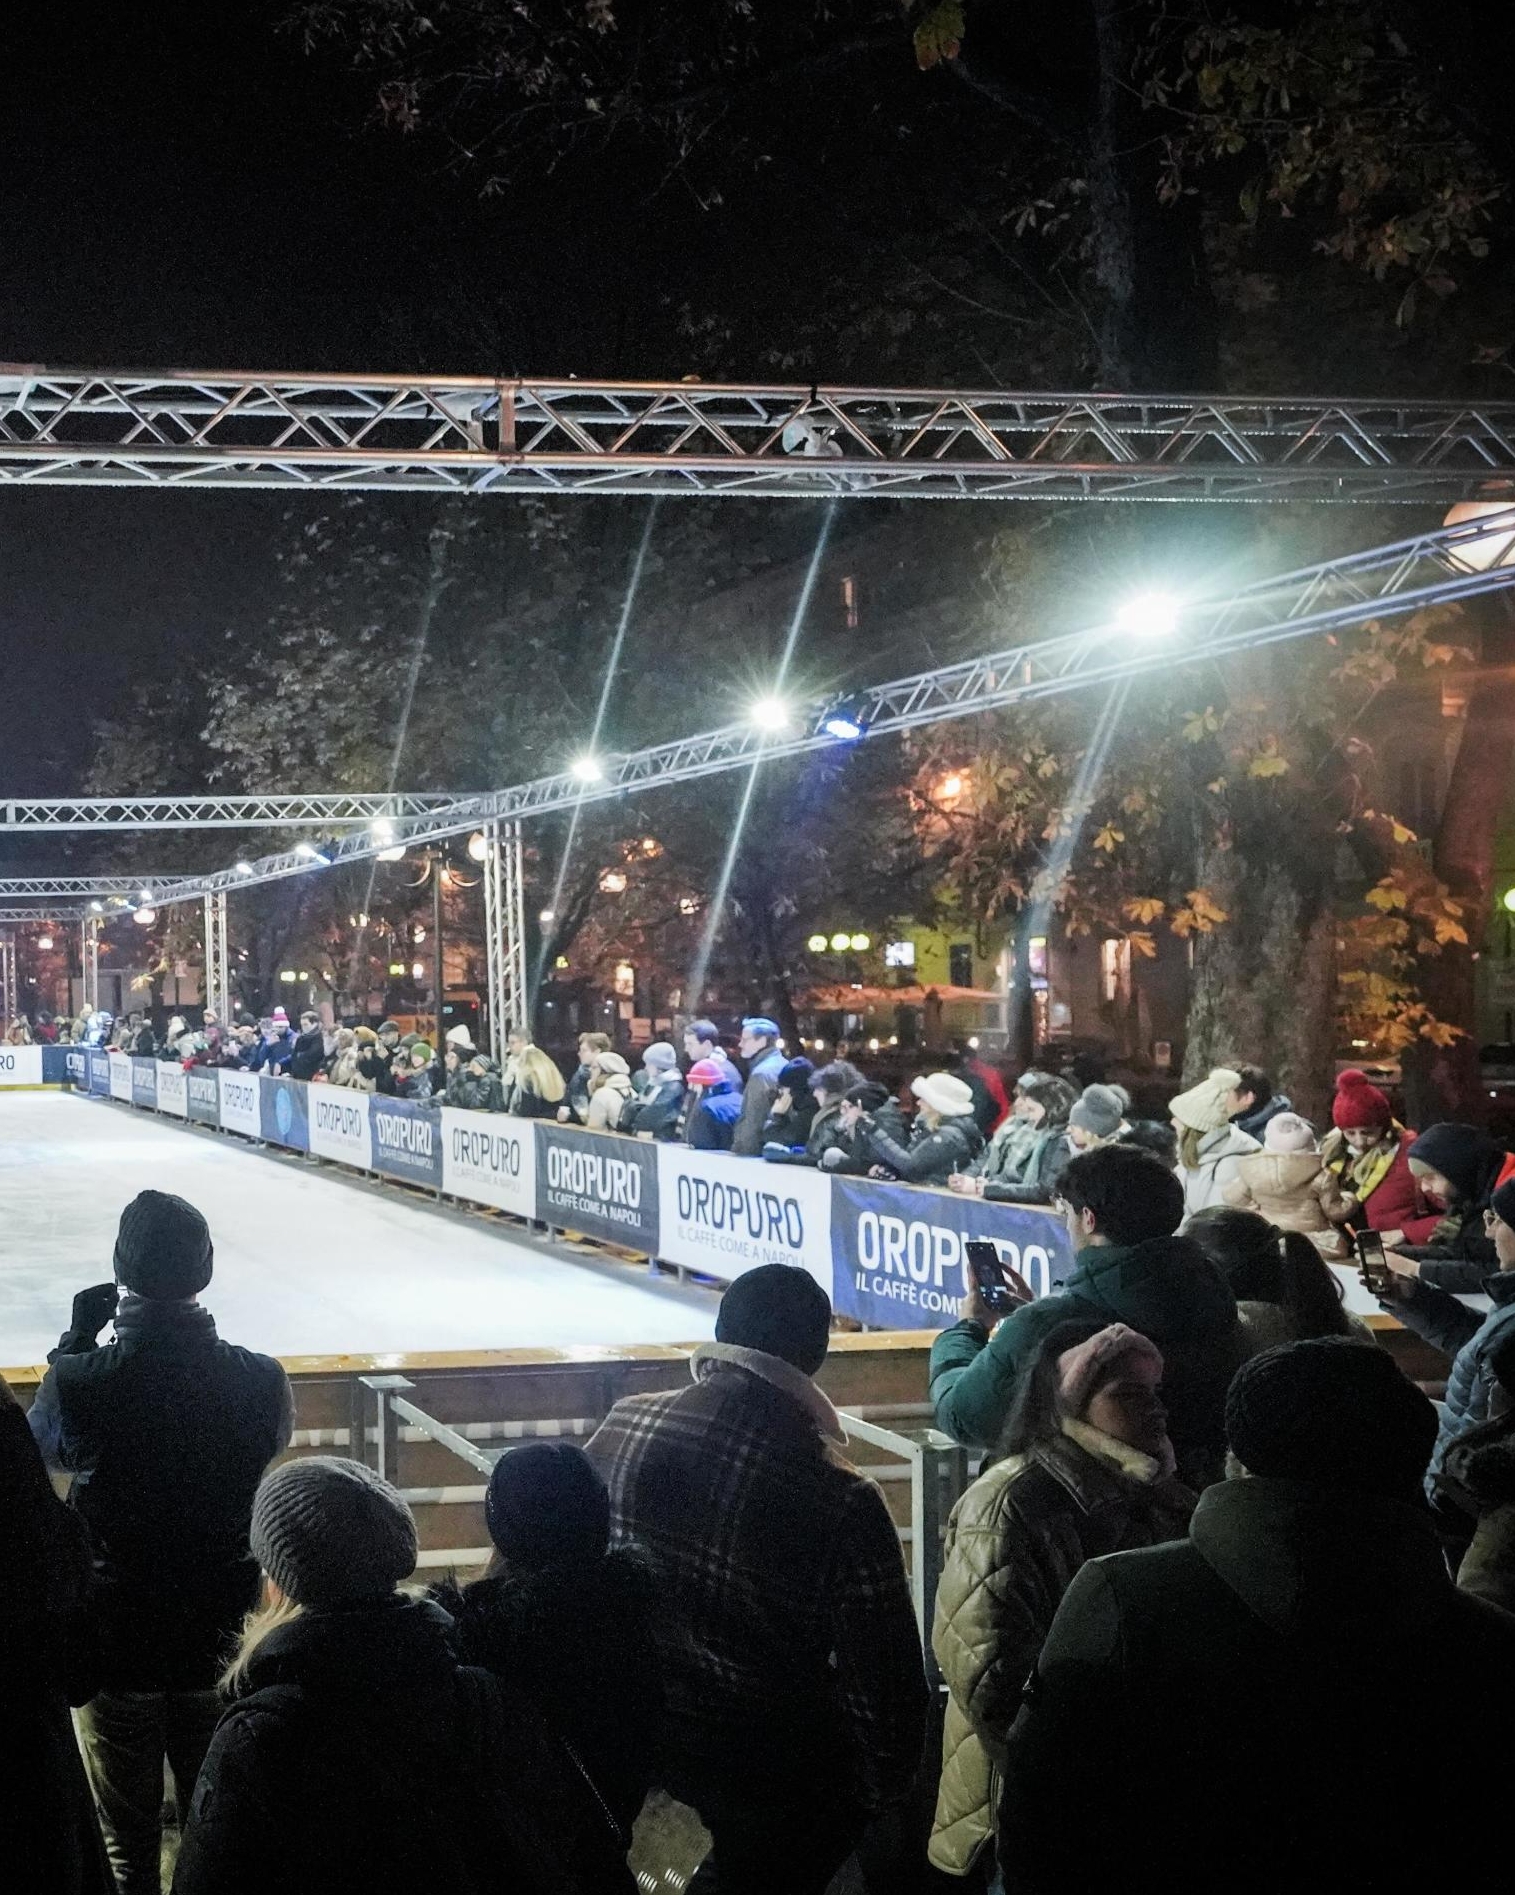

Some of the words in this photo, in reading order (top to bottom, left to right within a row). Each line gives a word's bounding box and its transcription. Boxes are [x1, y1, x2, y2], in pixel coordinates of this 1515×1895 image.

[317, 1101, 362, 1138] OROPURO
[376, 1113, 433, 1156] OROPURO
[453, 1128, 520, 1176] OROPURO
[547, 1146, 641, 1209] OROPURO
[609, 1205, 641, 1228] NAPOLI
[678, 1174, 804, 1249] OROPURO
[855, 1271, 870, 1293] IL
[872, 1276, 918, 1305] CAFFÈ
